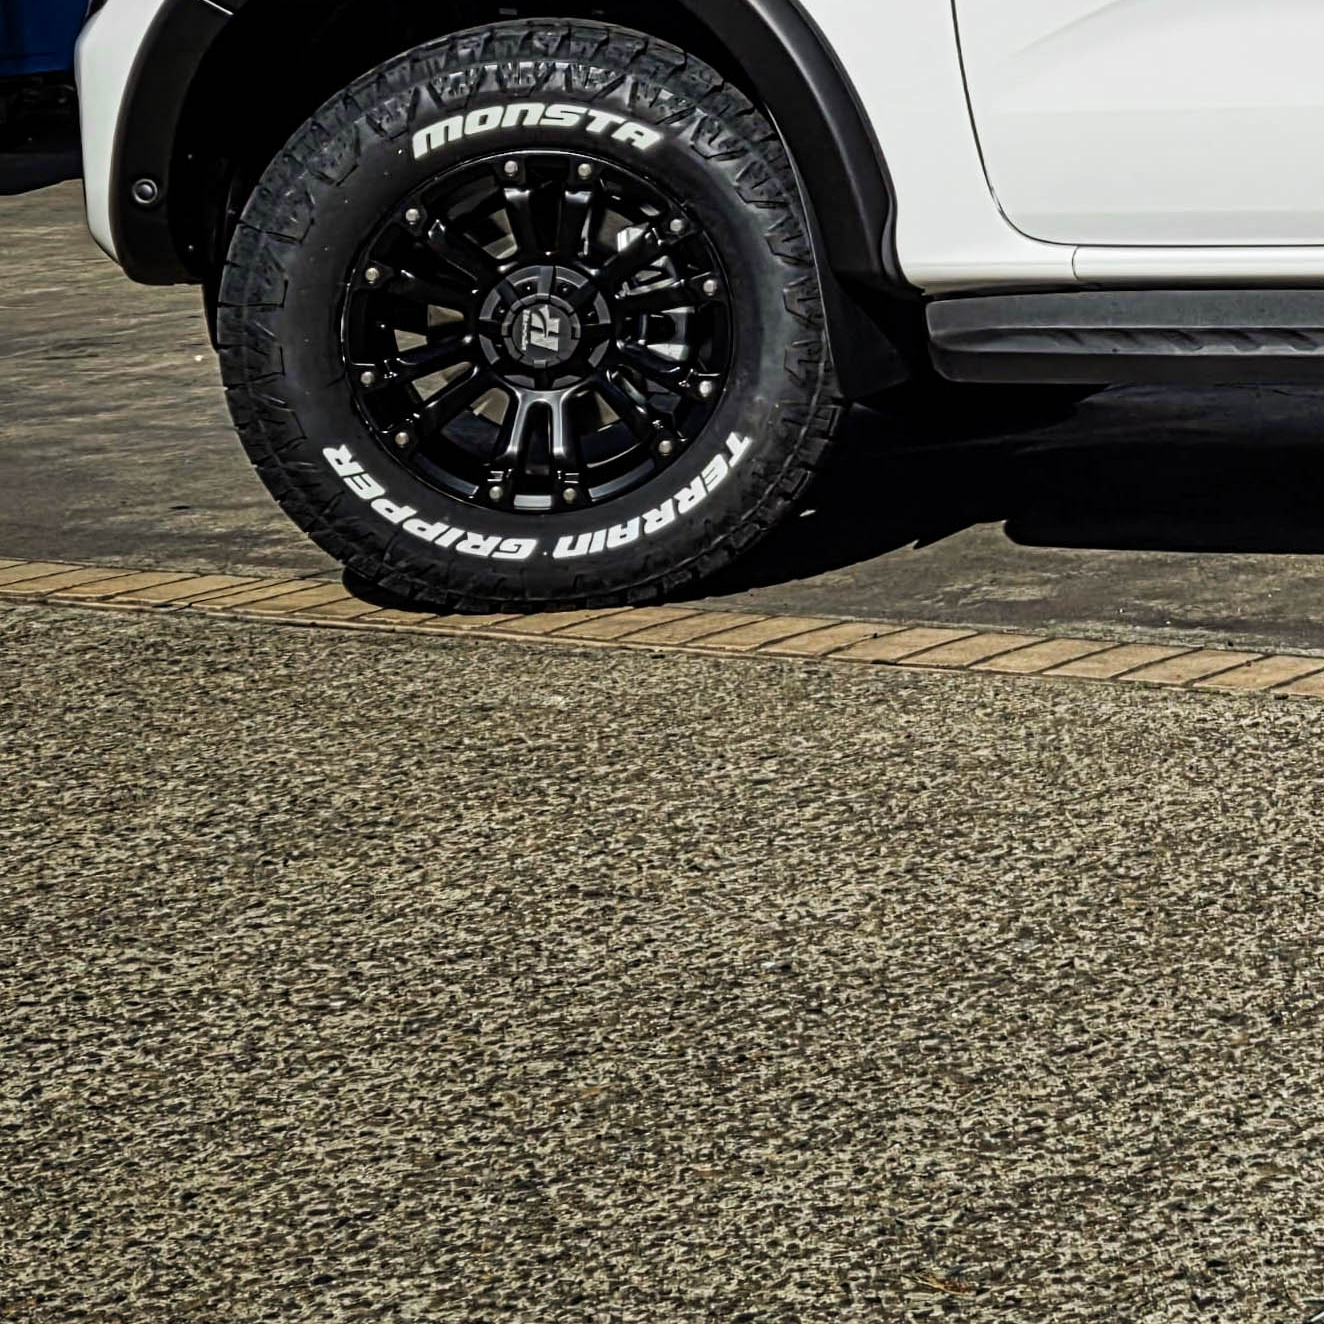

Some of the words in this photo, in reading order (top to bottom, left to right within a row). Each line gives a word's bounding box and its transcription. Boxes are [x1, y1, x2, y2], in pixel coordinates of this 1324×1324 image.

[412, 102, 667, 160] MONSTA
[322, 443, 540, 561] GRIPPER
[552, 431, 754, 559] TERRAIN
